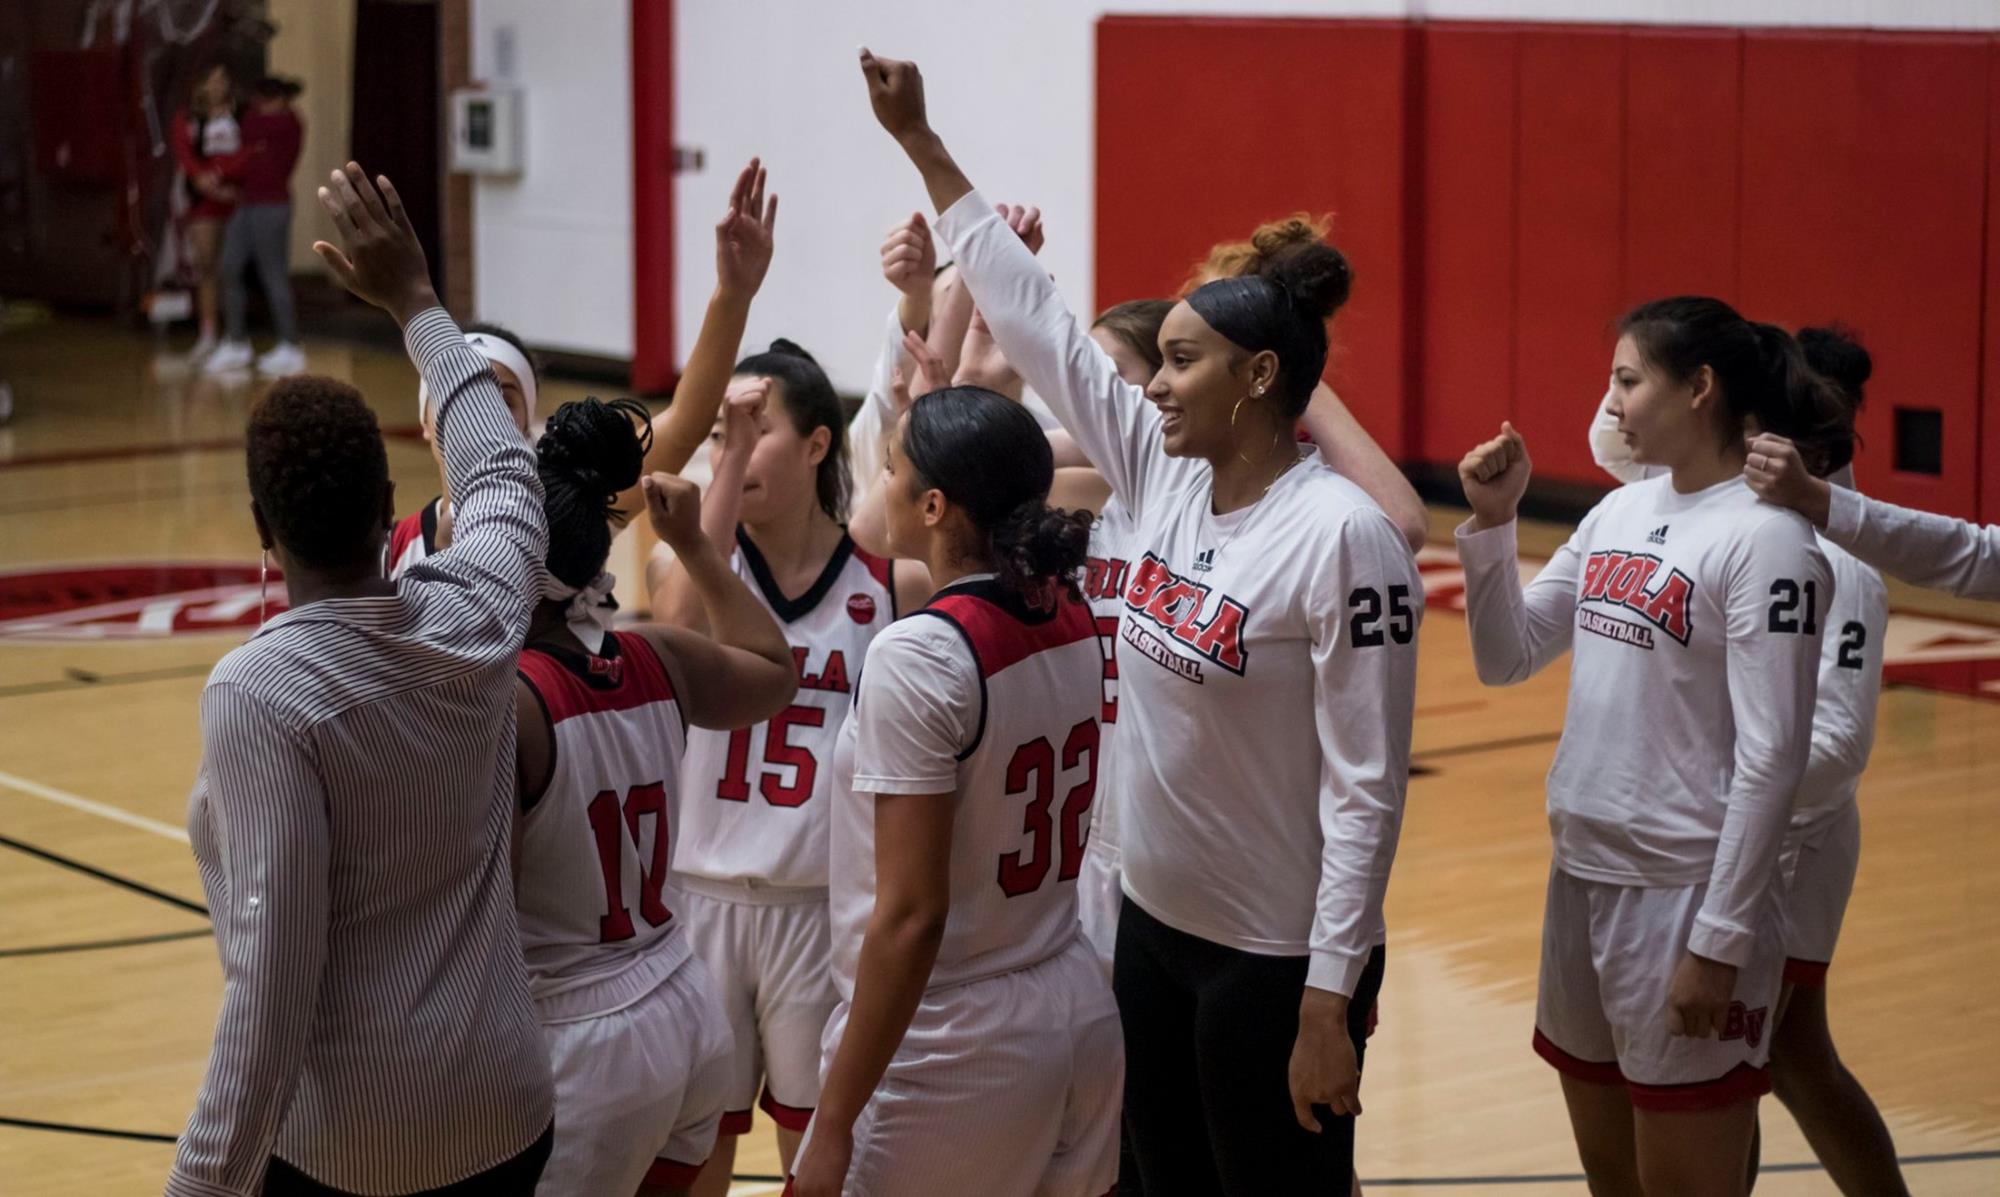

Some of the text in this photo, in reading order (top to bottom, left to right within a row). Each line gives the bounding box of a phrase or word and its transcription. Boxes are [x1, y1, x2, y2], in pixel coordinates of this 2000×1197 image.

[1084, 556, 1131, 602] BI
[1577, 550, 1695, 647] BIOLA
[1768, 579, 1816, 635] 21
[1348, 584, 1413, 648] 25
[1837, 620, 1866, 670] 2
[1122, 615, 1204, 684] BASKETBALL
[717, 705, 824, 808] 15
[996, 716, 1100, 898] 32
[588, 780, 673, 943] 10
[1719, 1000, 1768, 1049] BU
